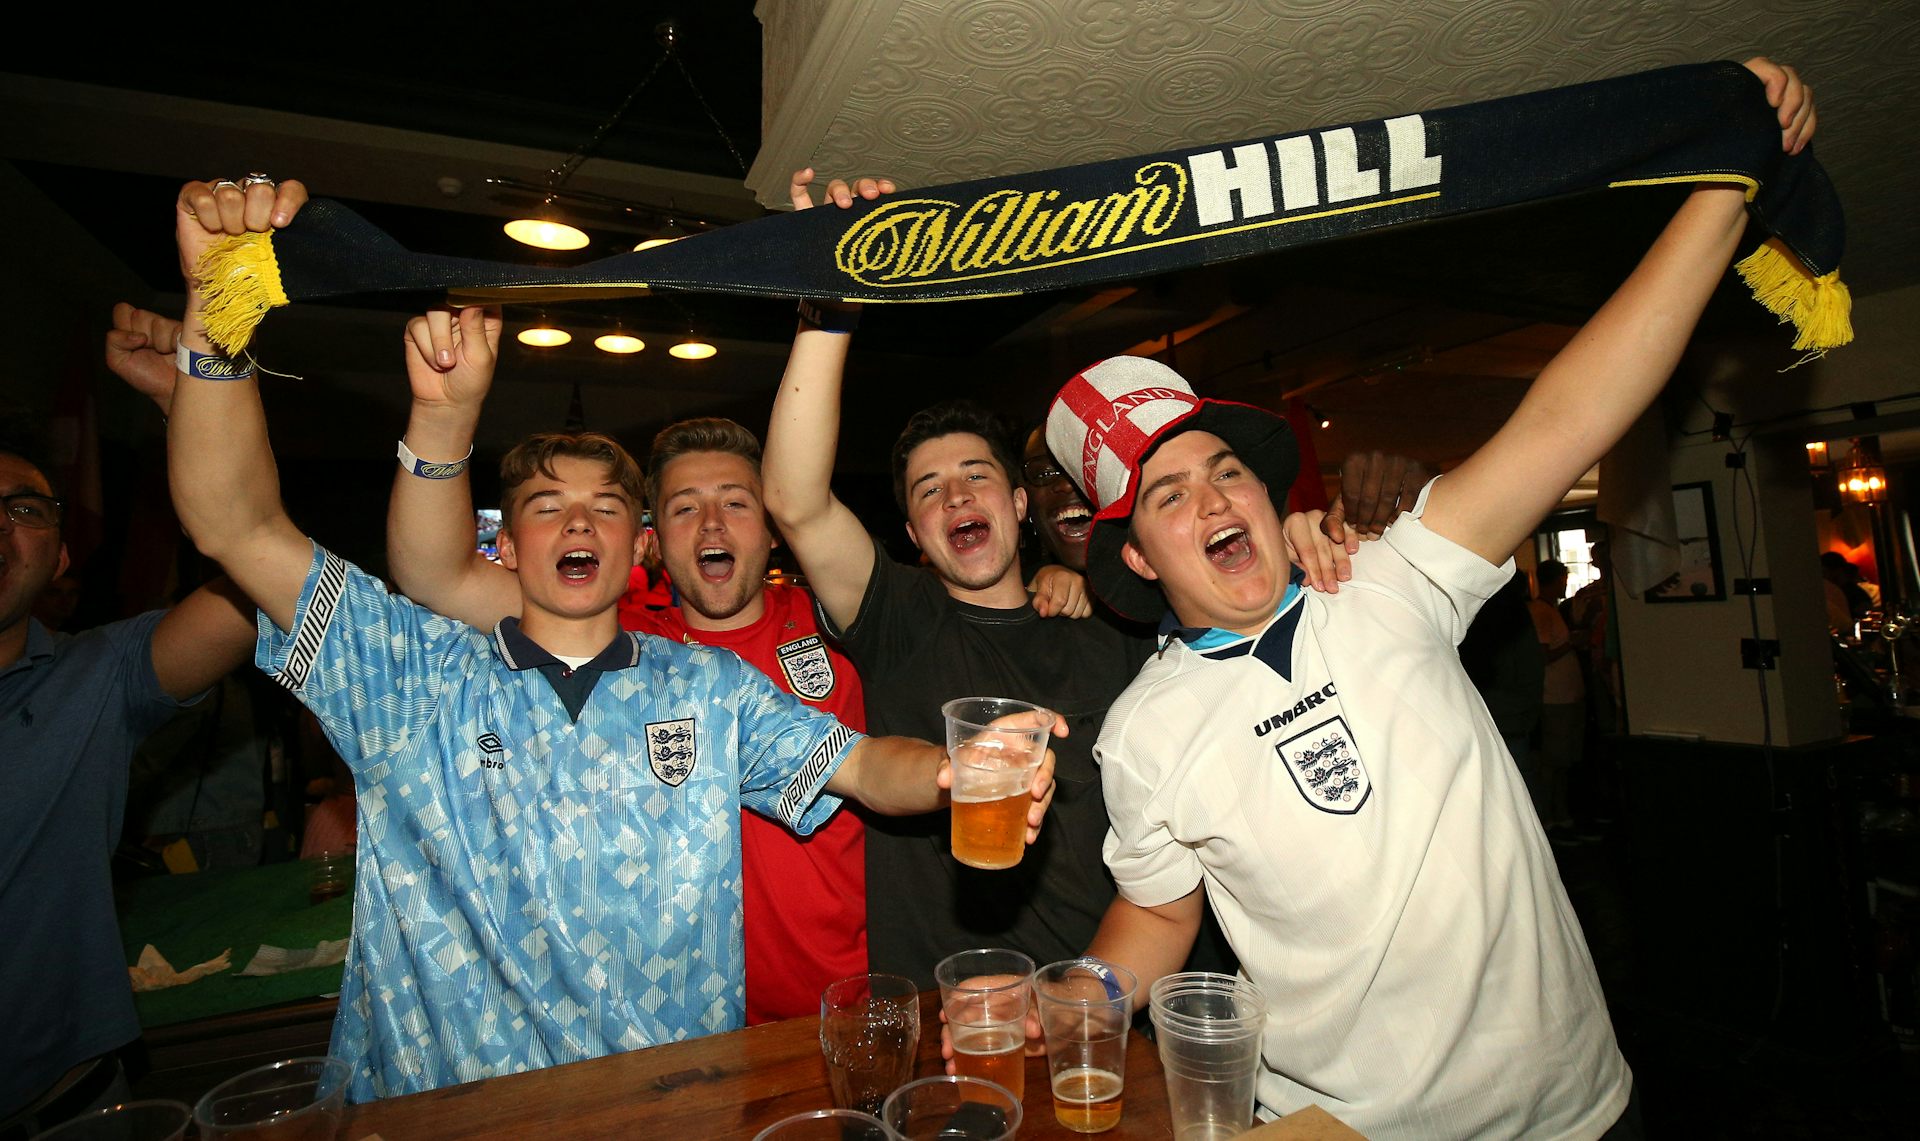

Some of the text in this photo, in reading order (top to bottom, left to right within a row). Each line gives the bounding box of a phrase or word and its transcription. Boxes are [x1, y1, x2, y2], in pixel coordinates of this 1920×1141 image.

[835, 114, 1443, 287] William HILL
[1083, 387, 1176, 490] ENGLAND
[780, 637, 819, 655] ENGLAND
